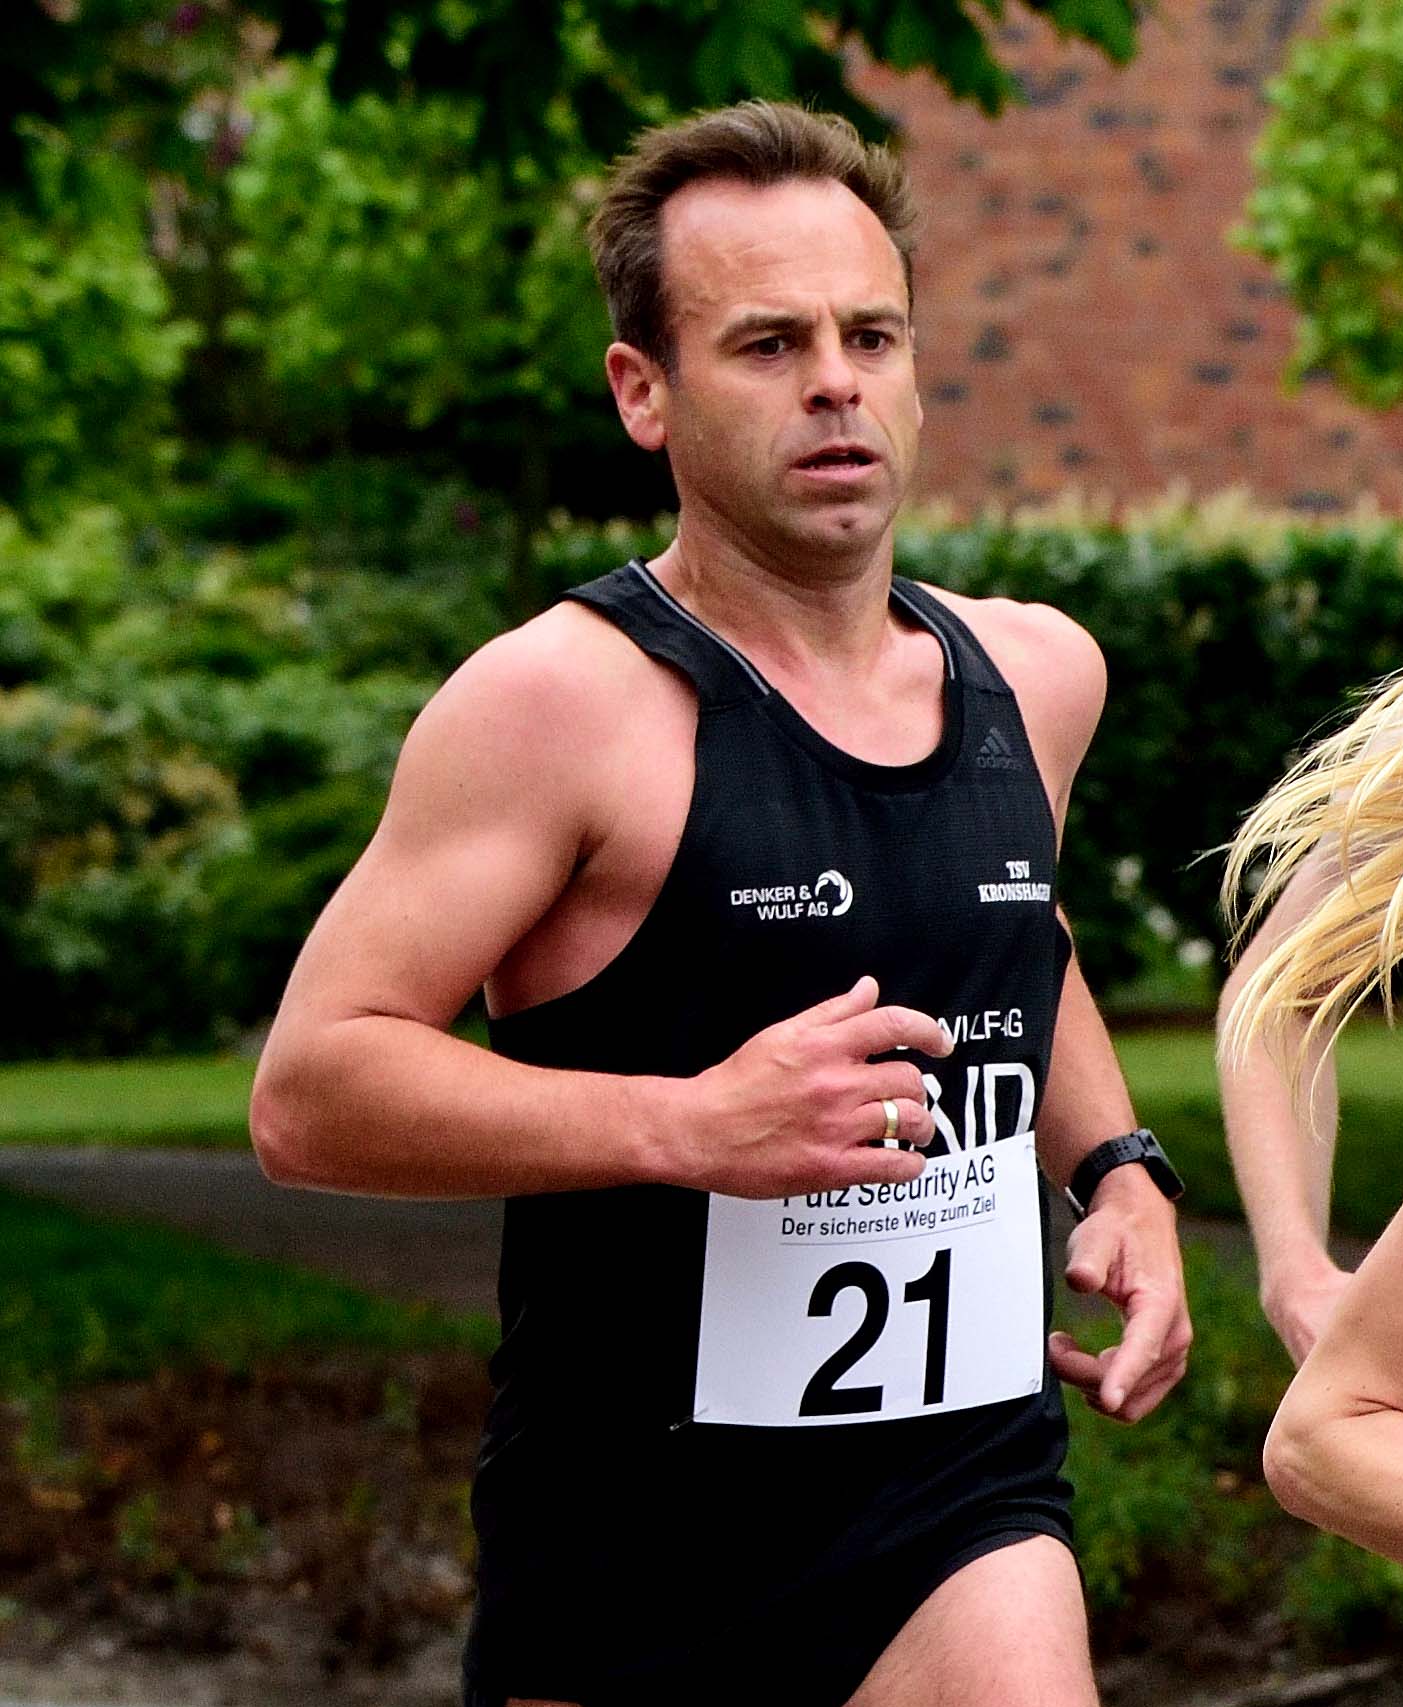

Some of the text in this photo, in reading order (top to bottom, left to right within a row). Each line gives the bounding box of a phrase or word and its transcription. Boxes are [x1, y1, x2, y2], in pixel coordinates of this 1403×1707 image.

[1005, 861, 1030, 879] TSV
[730, 885, 812, 905] DENKER &
[757, 901, 829, 920] WULF AG
[783, 1155, 995, 1208] tz Security AG
[781, 1193, 996, 1236] Der sicherste Weg zum Ziel
[798, 1248, 952, 1418] 21
